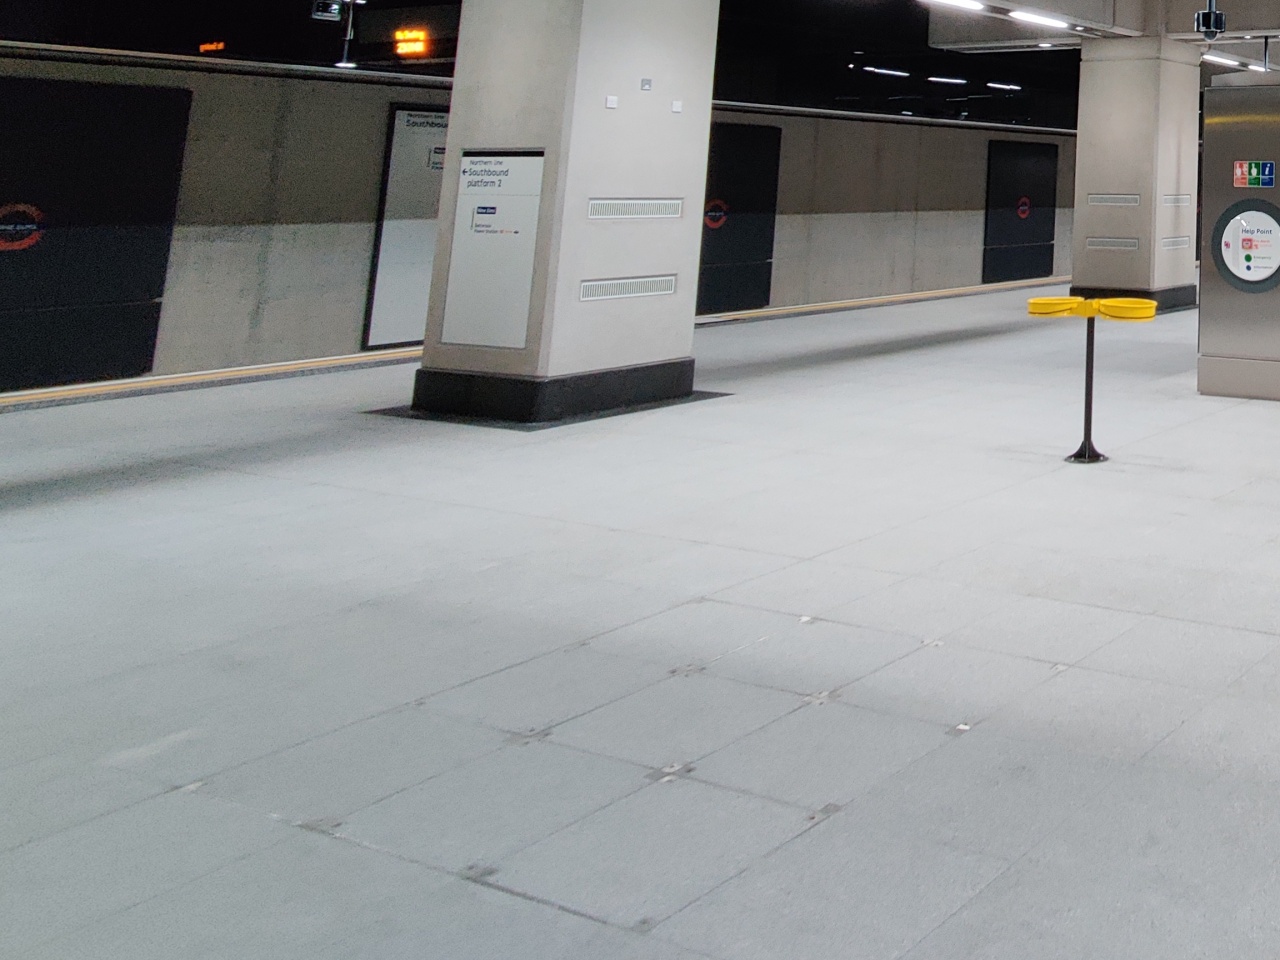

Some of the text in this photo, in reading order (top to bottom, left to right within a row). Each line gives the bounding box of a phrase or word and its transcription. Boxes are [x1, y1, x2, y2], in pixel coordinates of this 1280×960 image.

[468, 168, 510, 177] Southbound
[466, 178, 503, 189] platform 2
